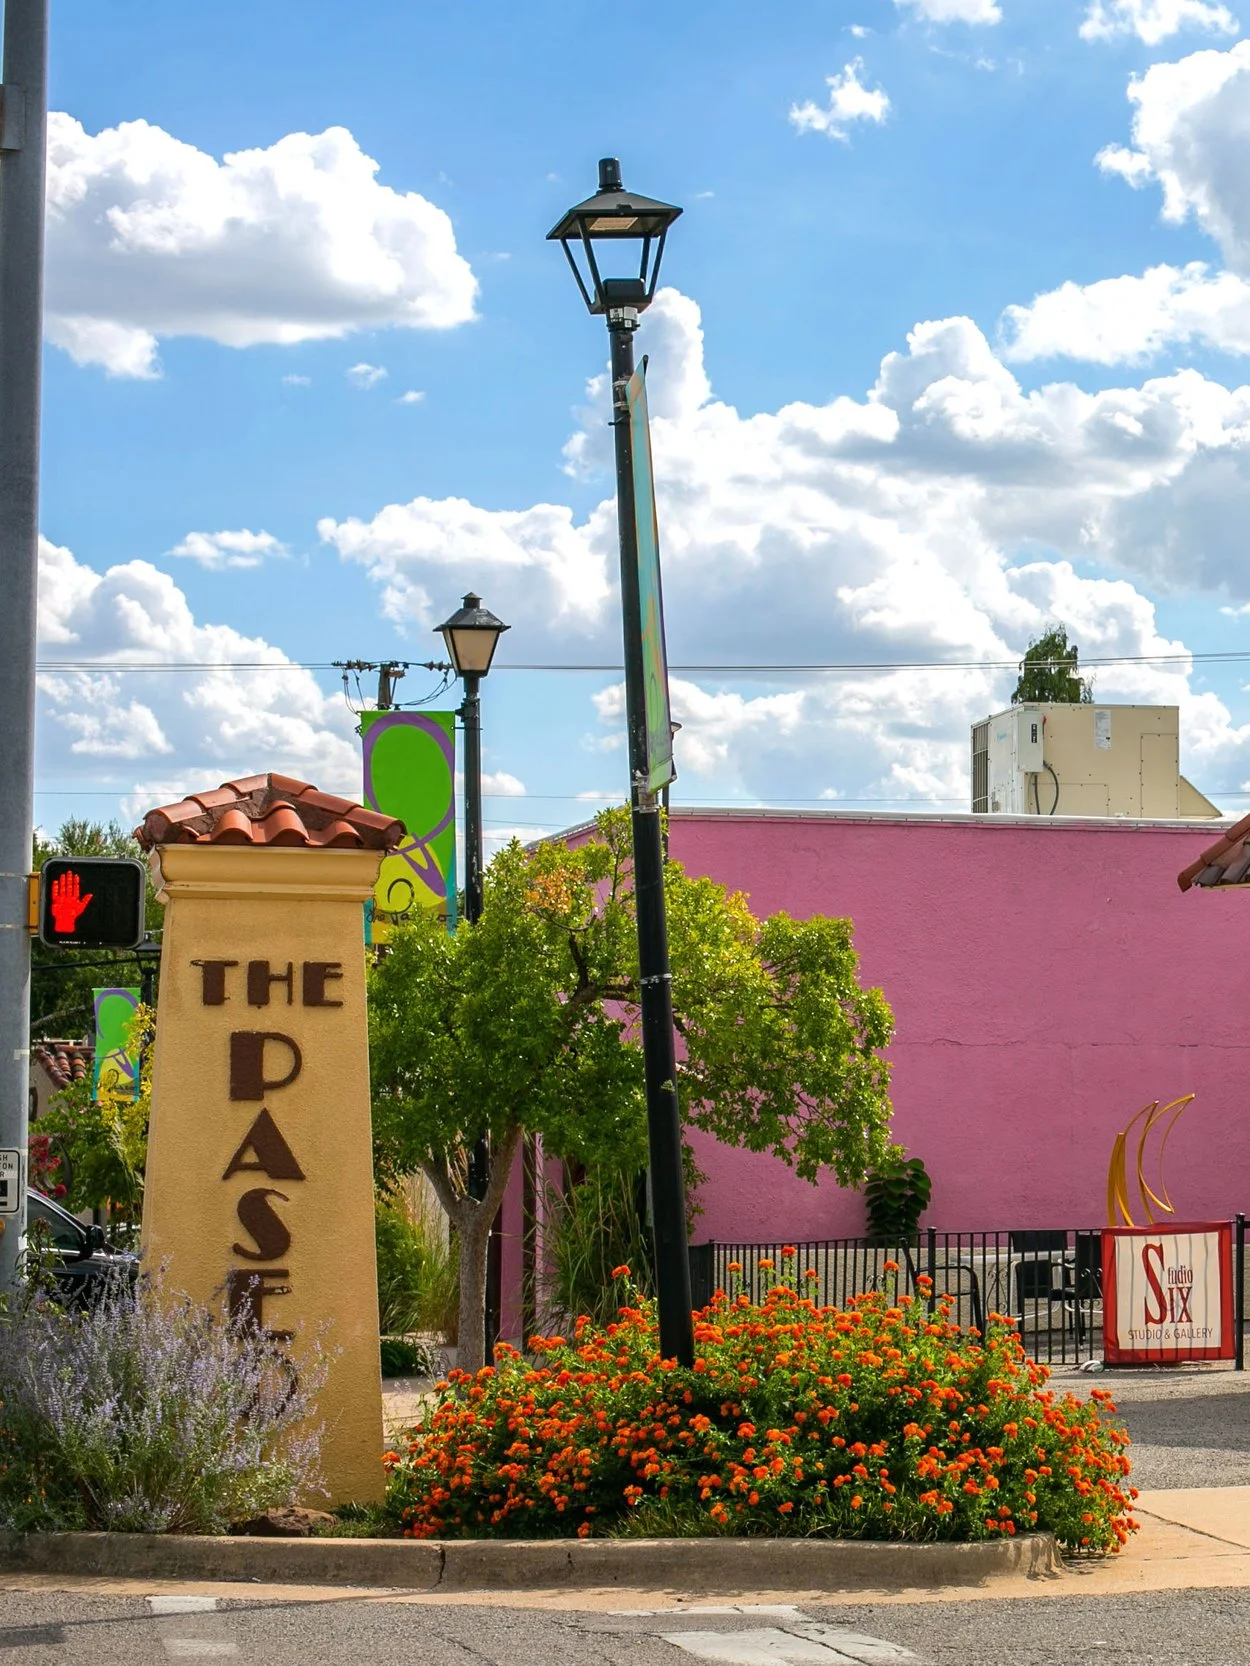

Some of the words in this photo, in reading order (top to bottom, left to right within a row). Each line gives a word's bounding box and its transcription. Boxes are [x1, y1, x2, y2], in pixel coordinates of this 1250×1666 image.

[190, 959, 344, 1007] THE
[1127, 1329, 1164, 1341] STUDIO
[1164, 1329, 1171, 1339] &
[1174, 1327, 1214, 1339] GALLERY
